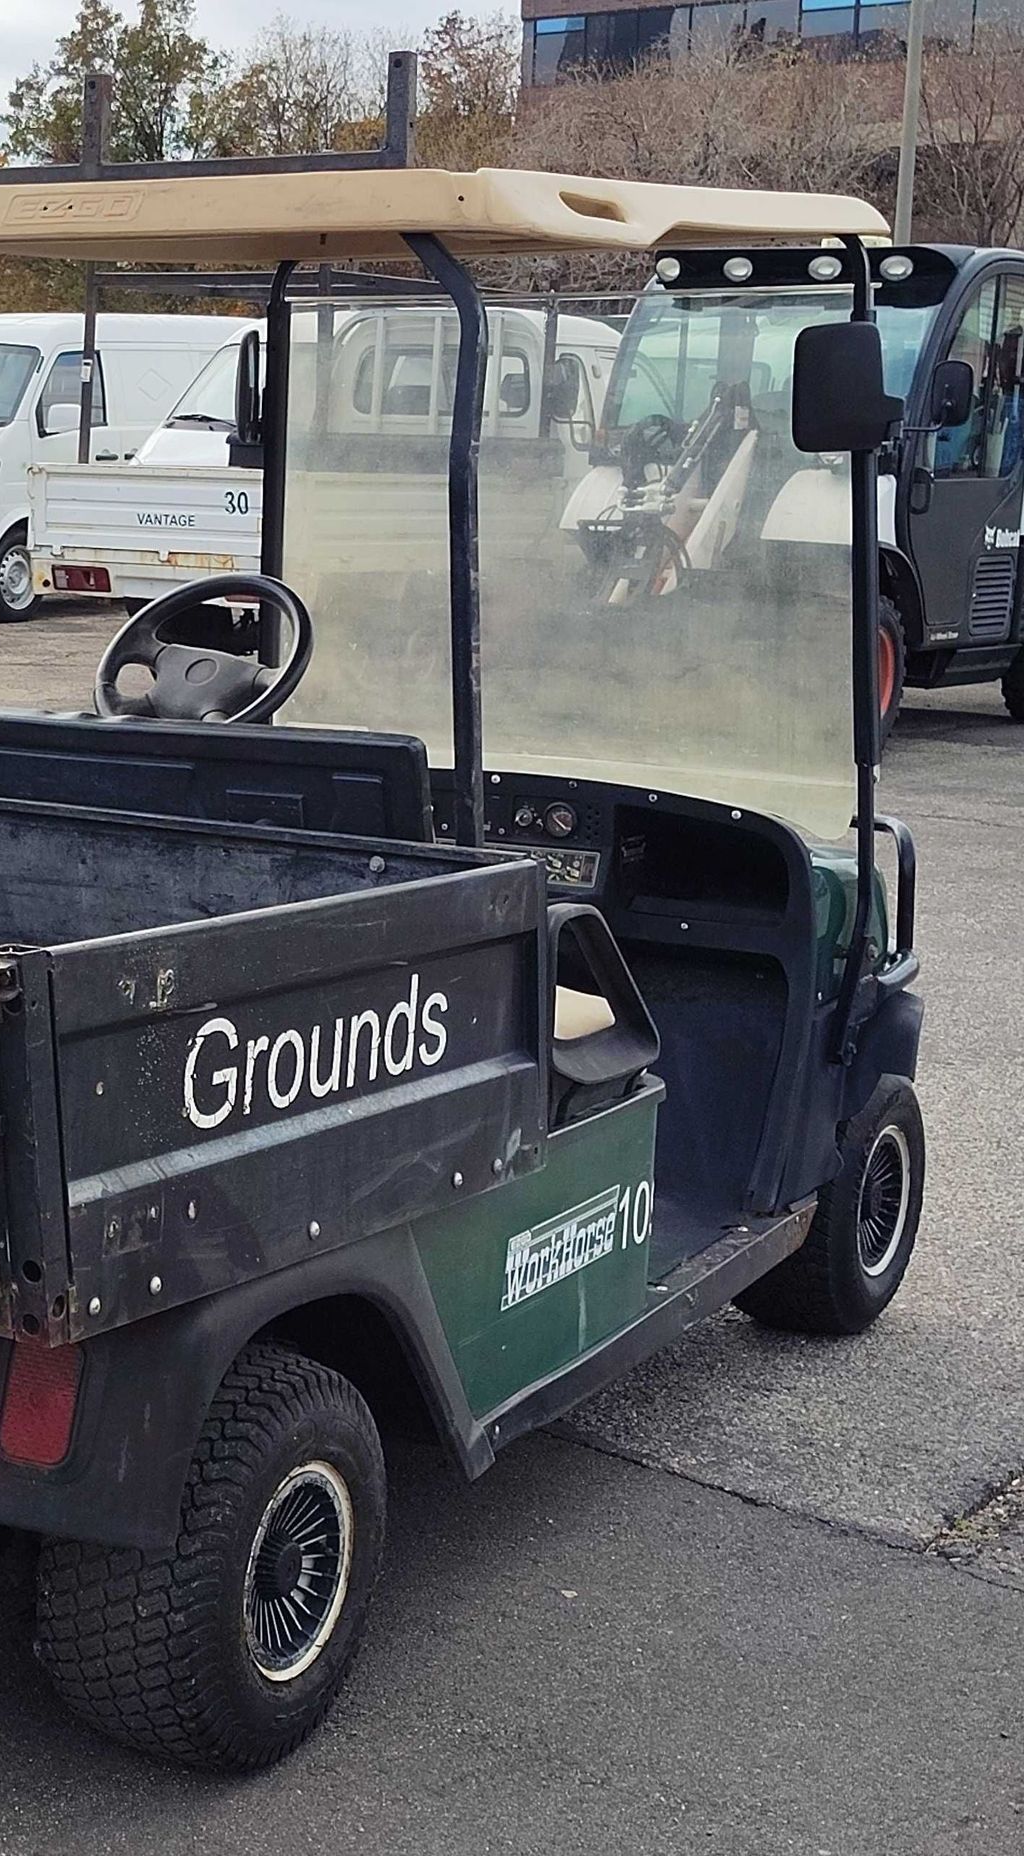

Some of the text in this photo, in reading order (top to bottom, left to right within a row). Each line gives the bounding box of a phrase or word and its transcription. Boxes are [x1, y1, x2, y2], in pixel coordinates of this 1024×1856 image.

[137, 513, 196, 527] VANTAGE
[224, 491, 249, 515] 30
[183, 973, 448, 1129] Grounds
[619, 1181, 654, 1250] 10
